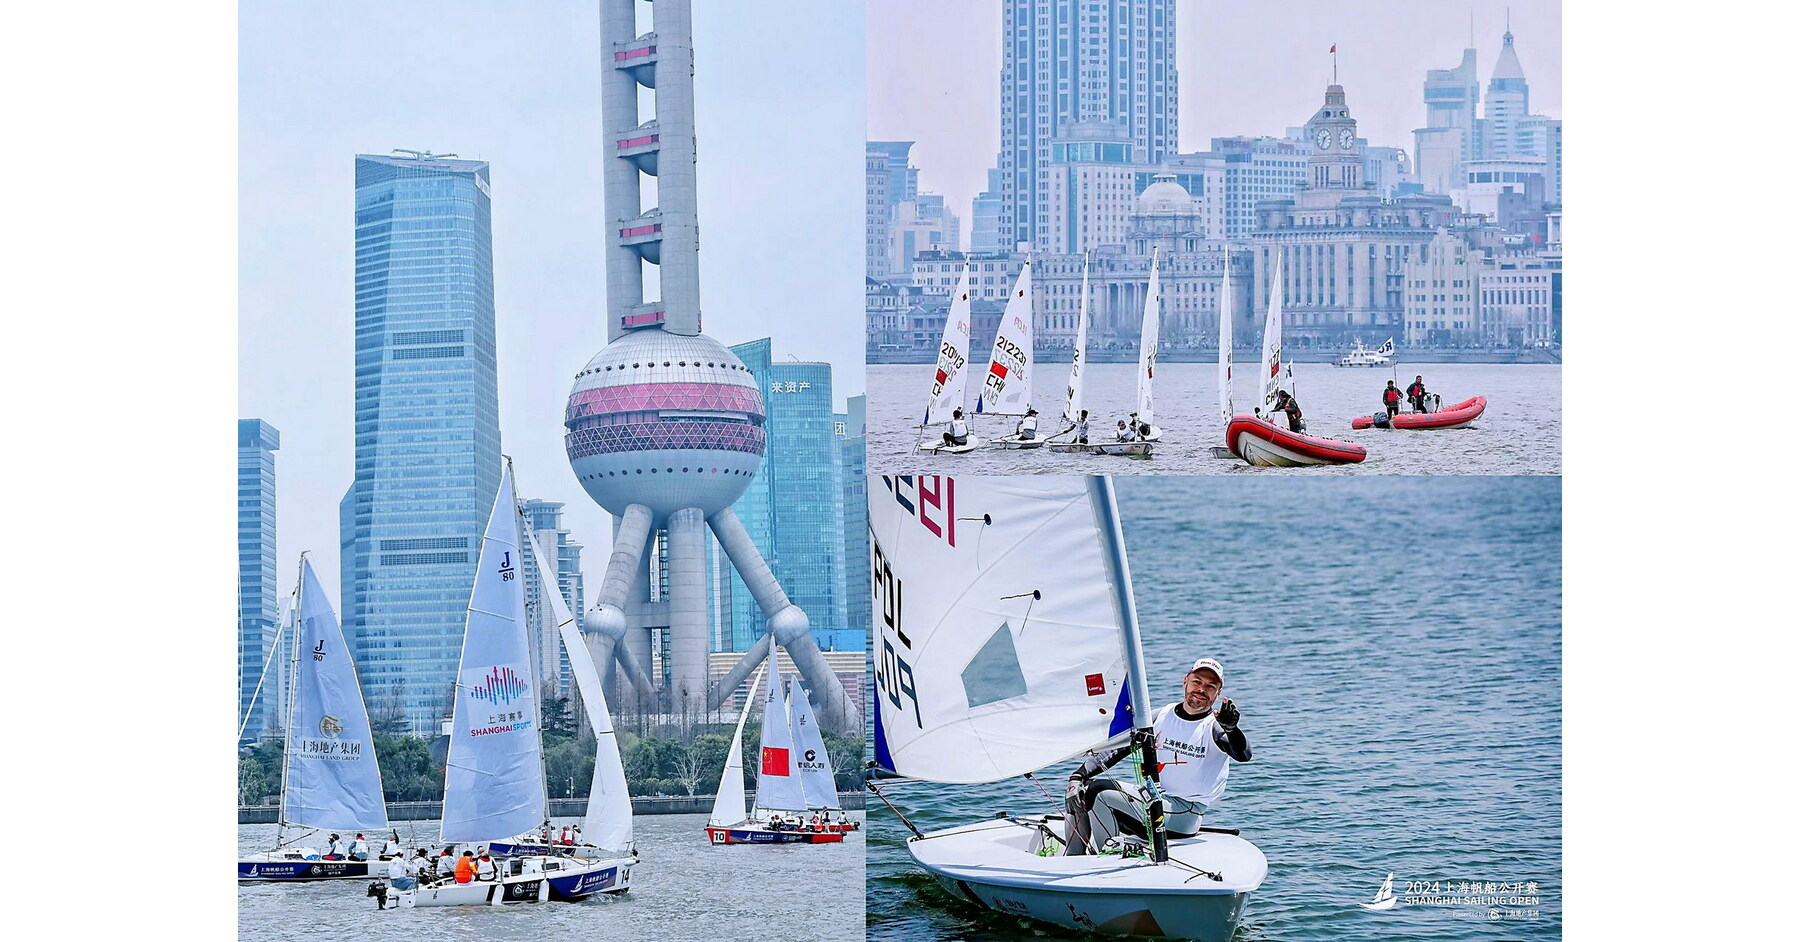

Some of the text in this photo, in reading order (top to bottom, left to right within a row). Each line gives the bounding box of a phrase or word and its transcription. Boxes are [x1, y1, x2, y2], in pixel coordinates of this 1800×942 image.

[834, 421, 846, 435] 团
[501, 551, 511, 568] J
[502, 571, 515, 582] 80
[874, 540, 911, 651] POL
[315, 639, 325, 652] J
[313, 654, 323, 662] 80
[714, 832, 725, 842] 10
[621, 868, 630, 885] 14
